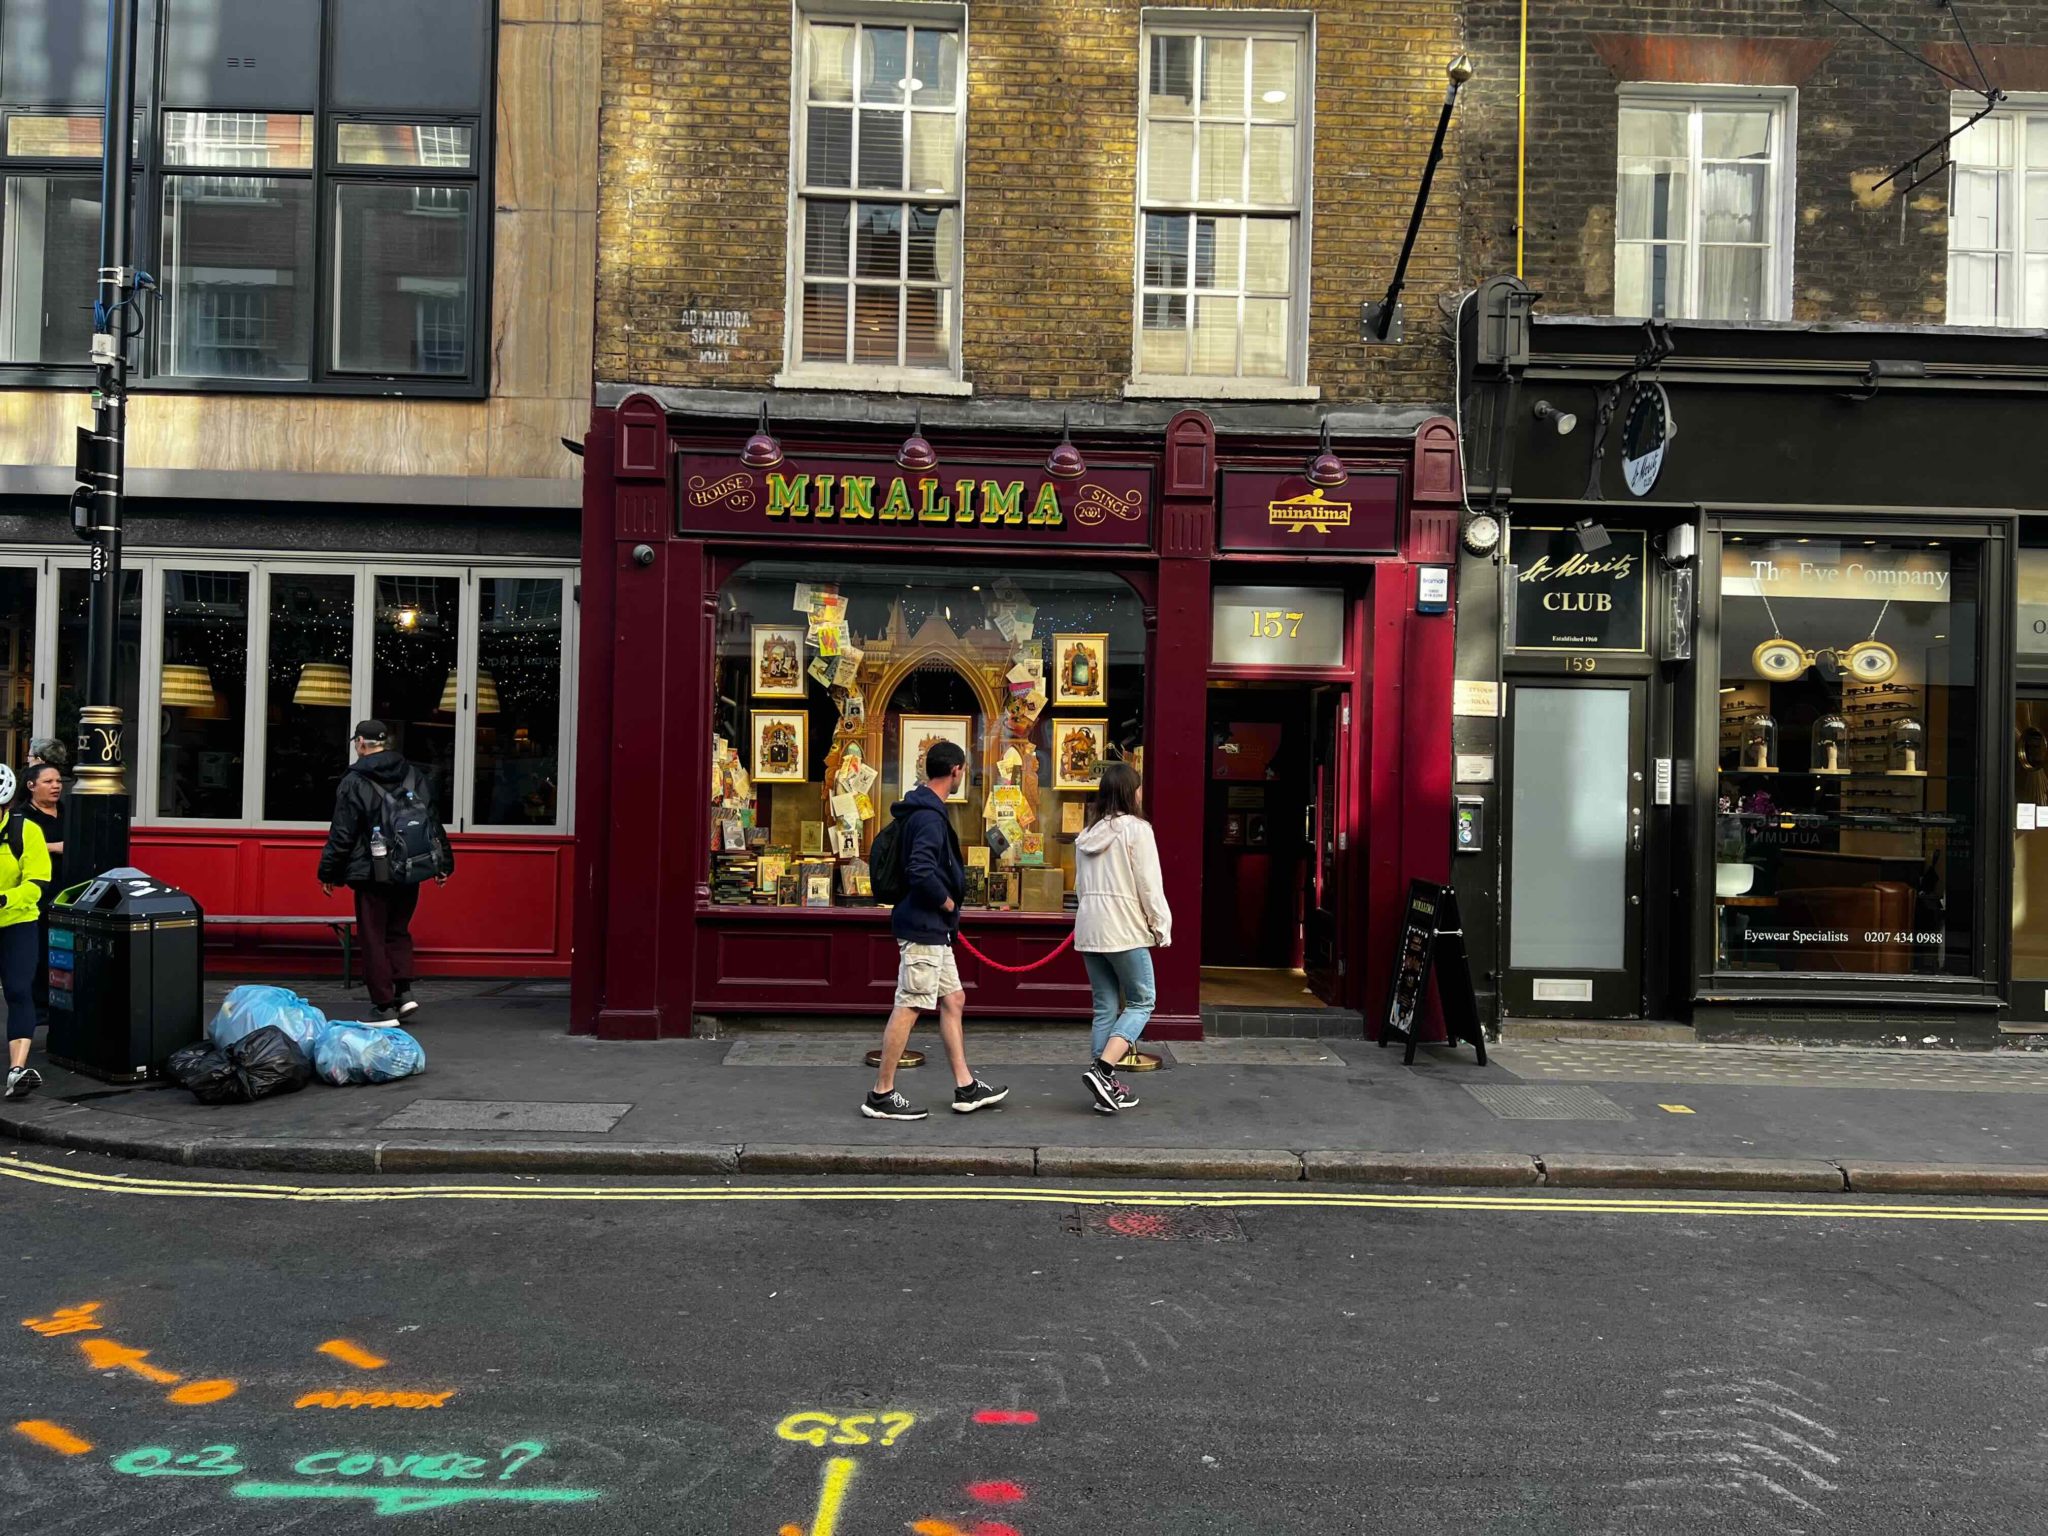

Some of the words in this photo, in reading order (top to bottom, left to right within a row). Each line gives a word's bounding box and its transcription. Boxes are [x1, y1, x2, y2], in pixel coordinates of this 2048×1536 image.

[681, 309, 697, 325] AD
[702, 310, 751, 328] MAIORA
[691, 328, 738, 345] SEMPER
[695, 477, 745, 504] HOUSE
[730, 494, 749, 506] OF
[766, 473, 1063, 526] MINALIMA
[1091, 489, 1130, 517] SINCE
[1272, 506, 1349, 520] minalima
[1514, 555, 1553, 582] St
[1541, 553, 1639, 580] Moritz
[1751, 560, 1791, 581] The
[1846, 563, 1949, 590] Company
[1542, 592, 1612, 612] CLUB
[1250, 610, 1304, 639] 157
[1565, 656, 1596, 672] 159
[1744, 929, 1790, 942] Eyewear
[1792, 930, 1849, 943] Specialists
[1864, 931, 1891, 943] 0207
[1893, 932, 1914, 943] 434
[1916, 932, 1943, 944] 0988
